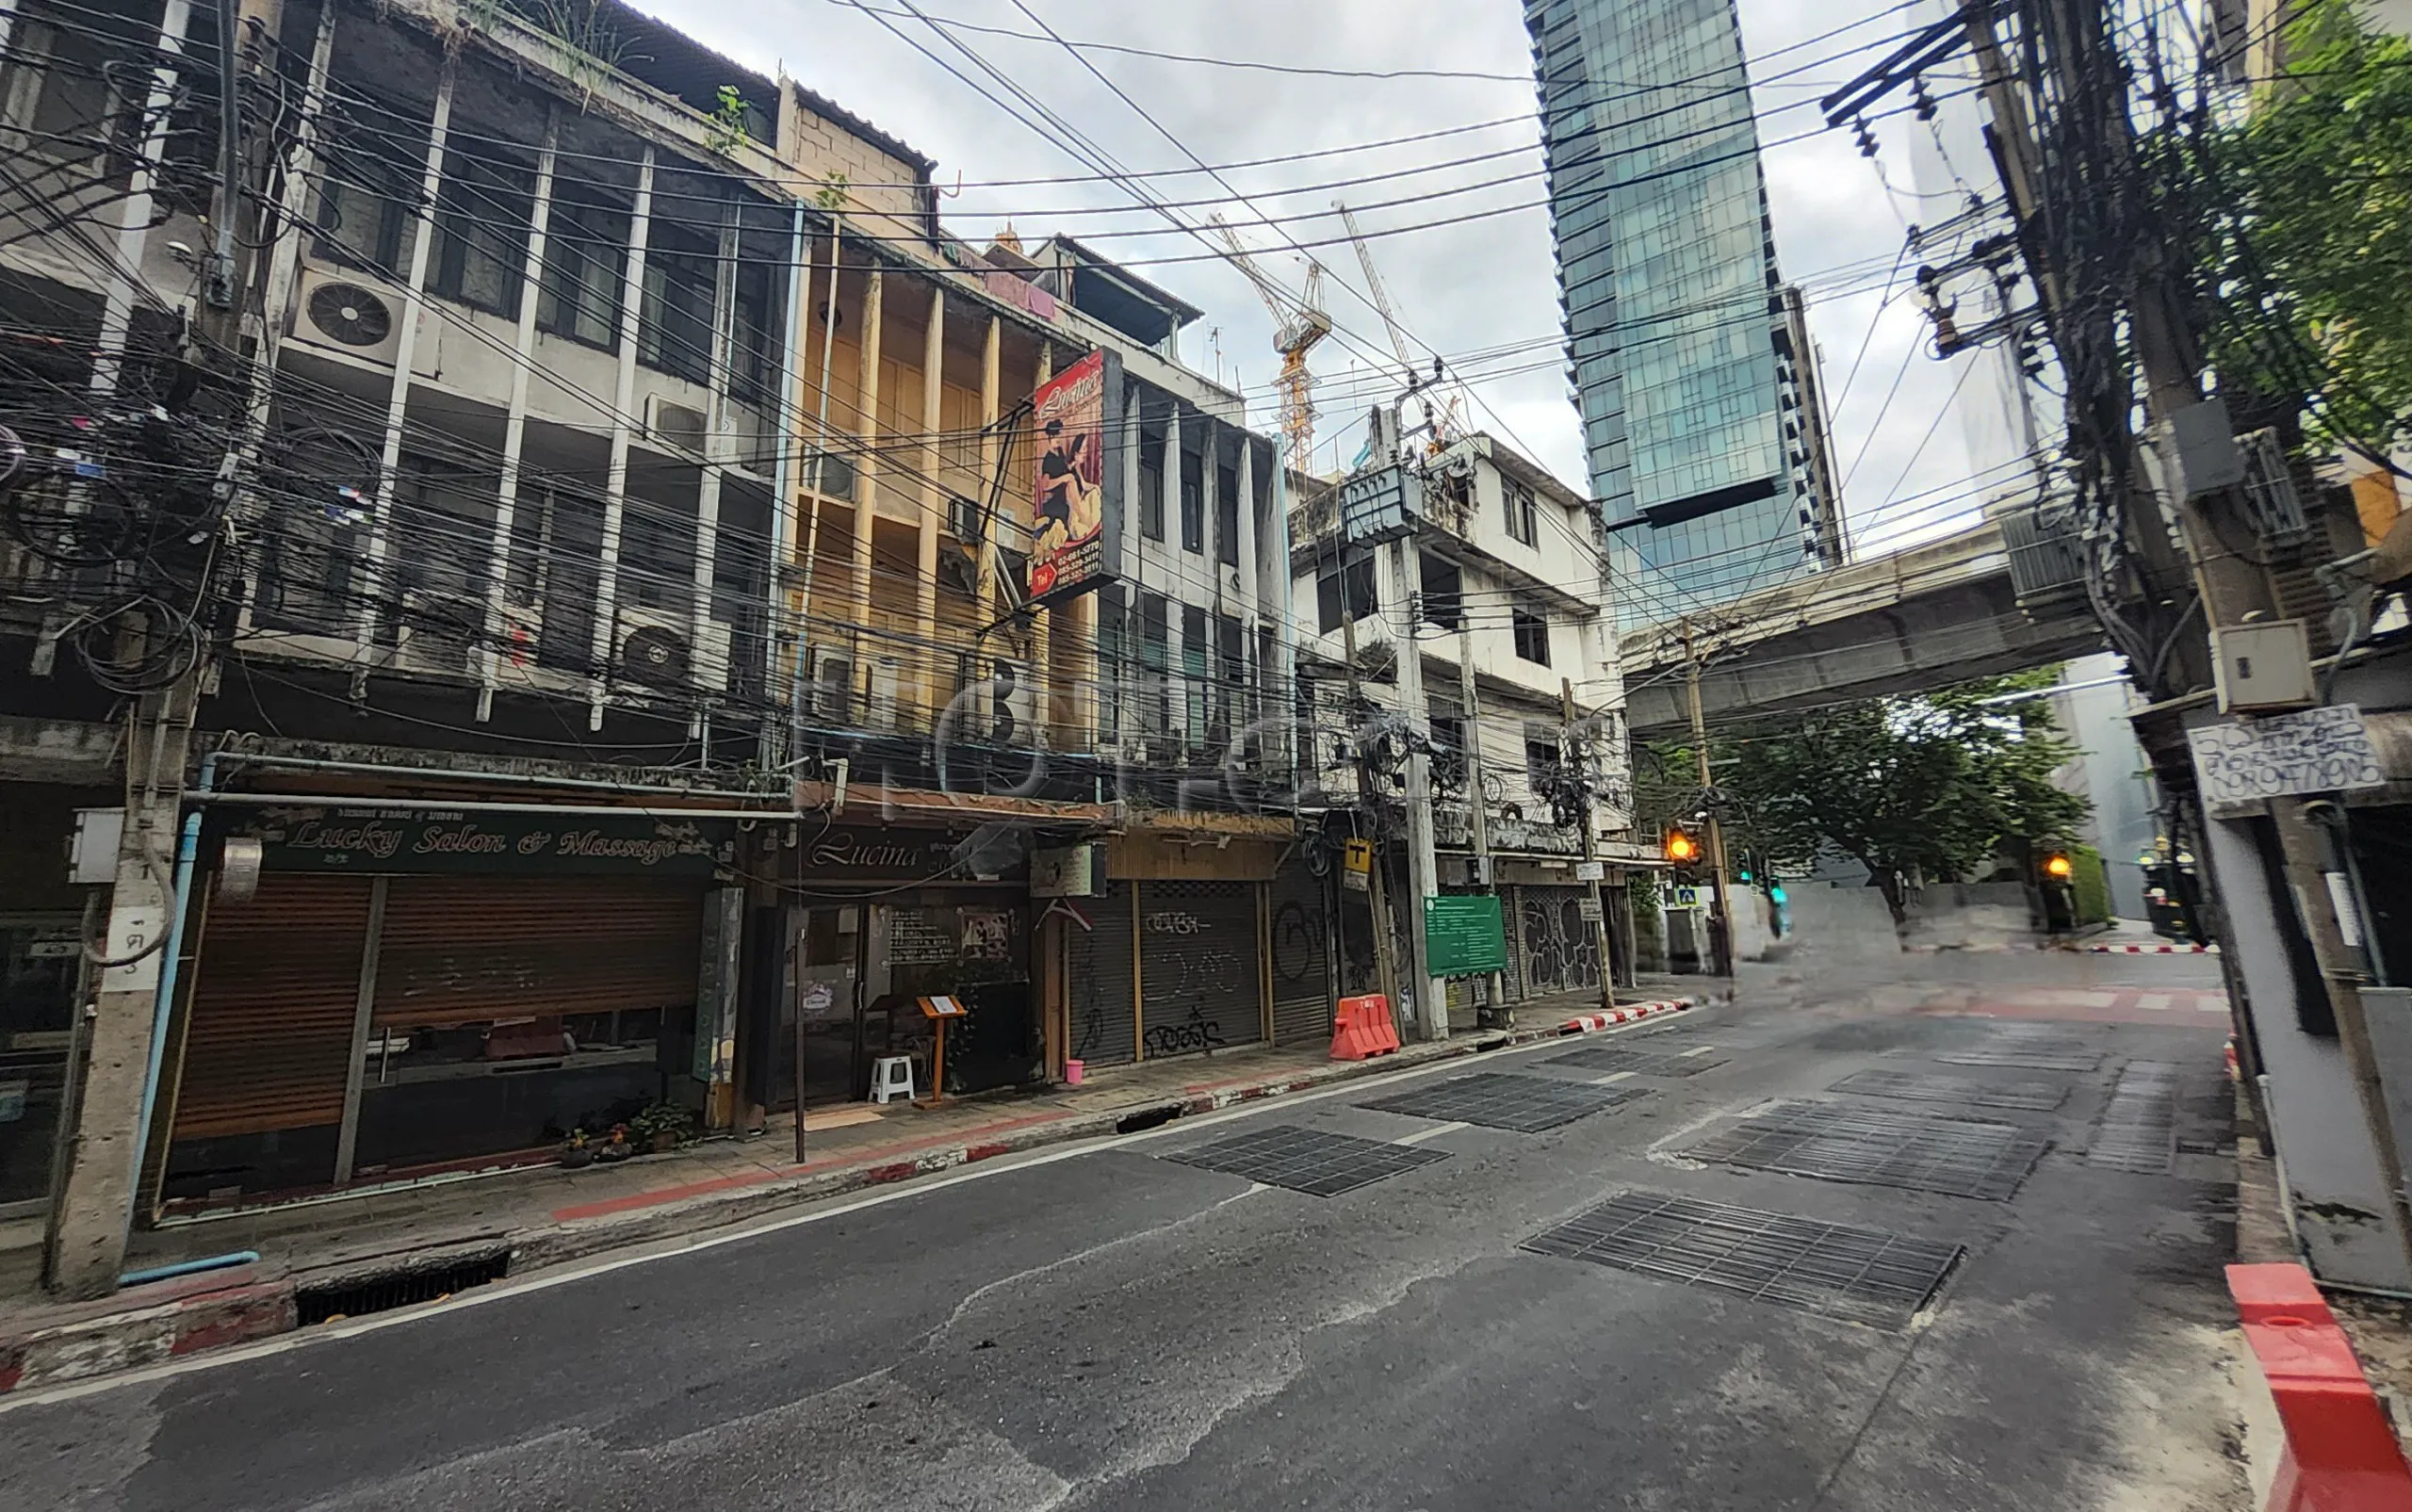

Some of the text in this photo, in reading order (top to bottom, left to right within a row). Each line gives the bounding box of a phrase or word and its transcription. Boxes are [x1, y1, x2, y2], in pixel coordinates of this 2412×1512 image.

[286, 821, 677, 866] Lucky Salon & Massage
[808, 832, 923, 868] Lucina
